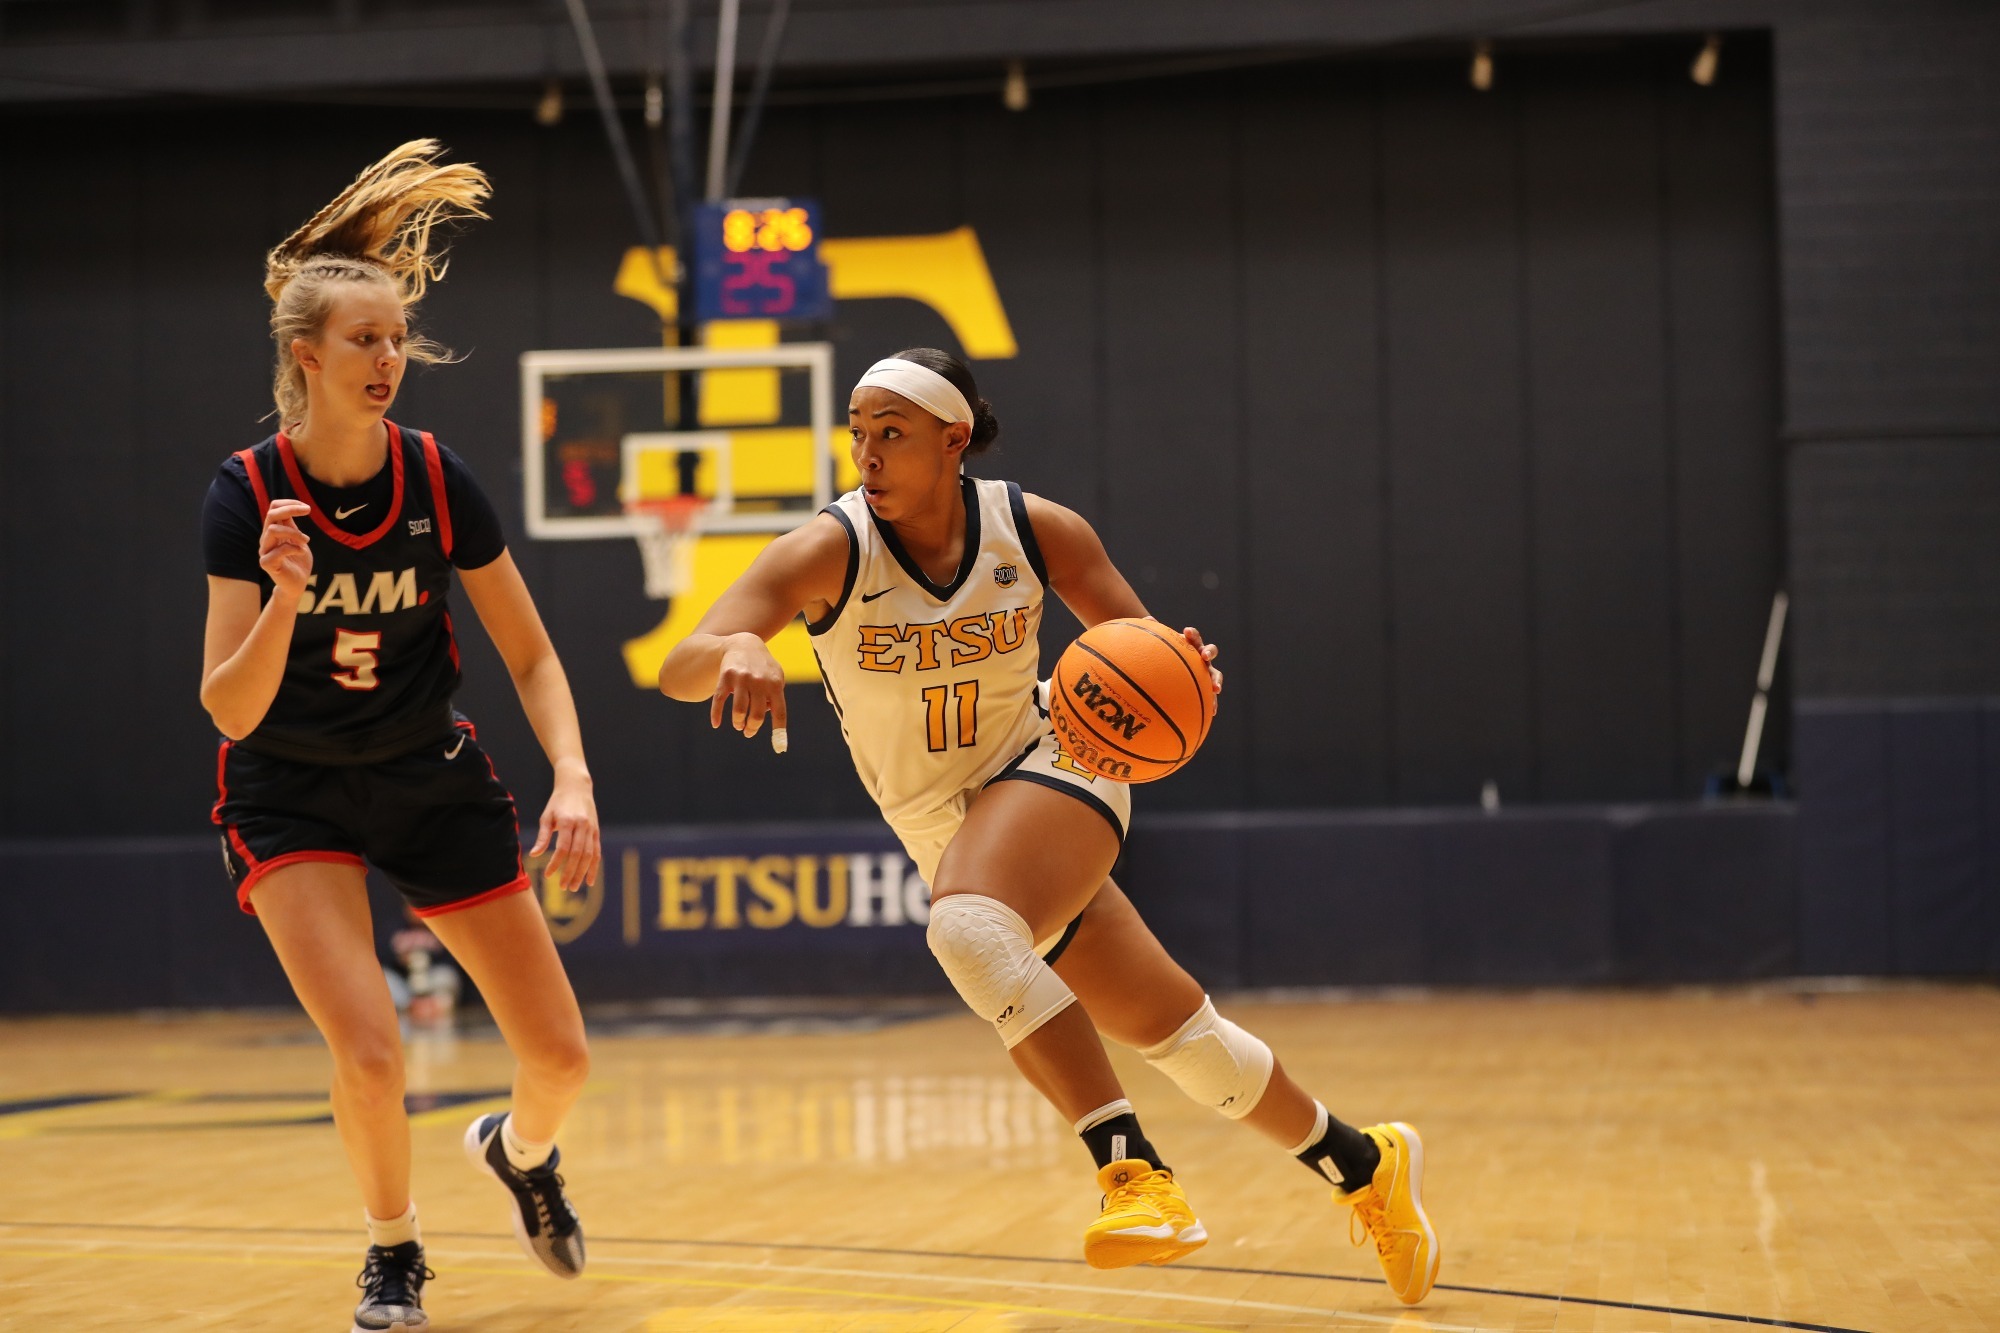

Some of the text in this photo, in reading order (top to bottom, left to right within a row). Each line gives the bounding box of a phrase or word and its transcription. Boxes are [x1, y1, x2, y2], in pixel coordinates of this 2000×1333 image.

[721, 250, 796, 314] 25
[330, 627, 382, 691] 5
[858, 606, 1030, 674] ETSU
[921, 679, 979, 753] 11
[1073, 672, 1147, 741] NCAA
